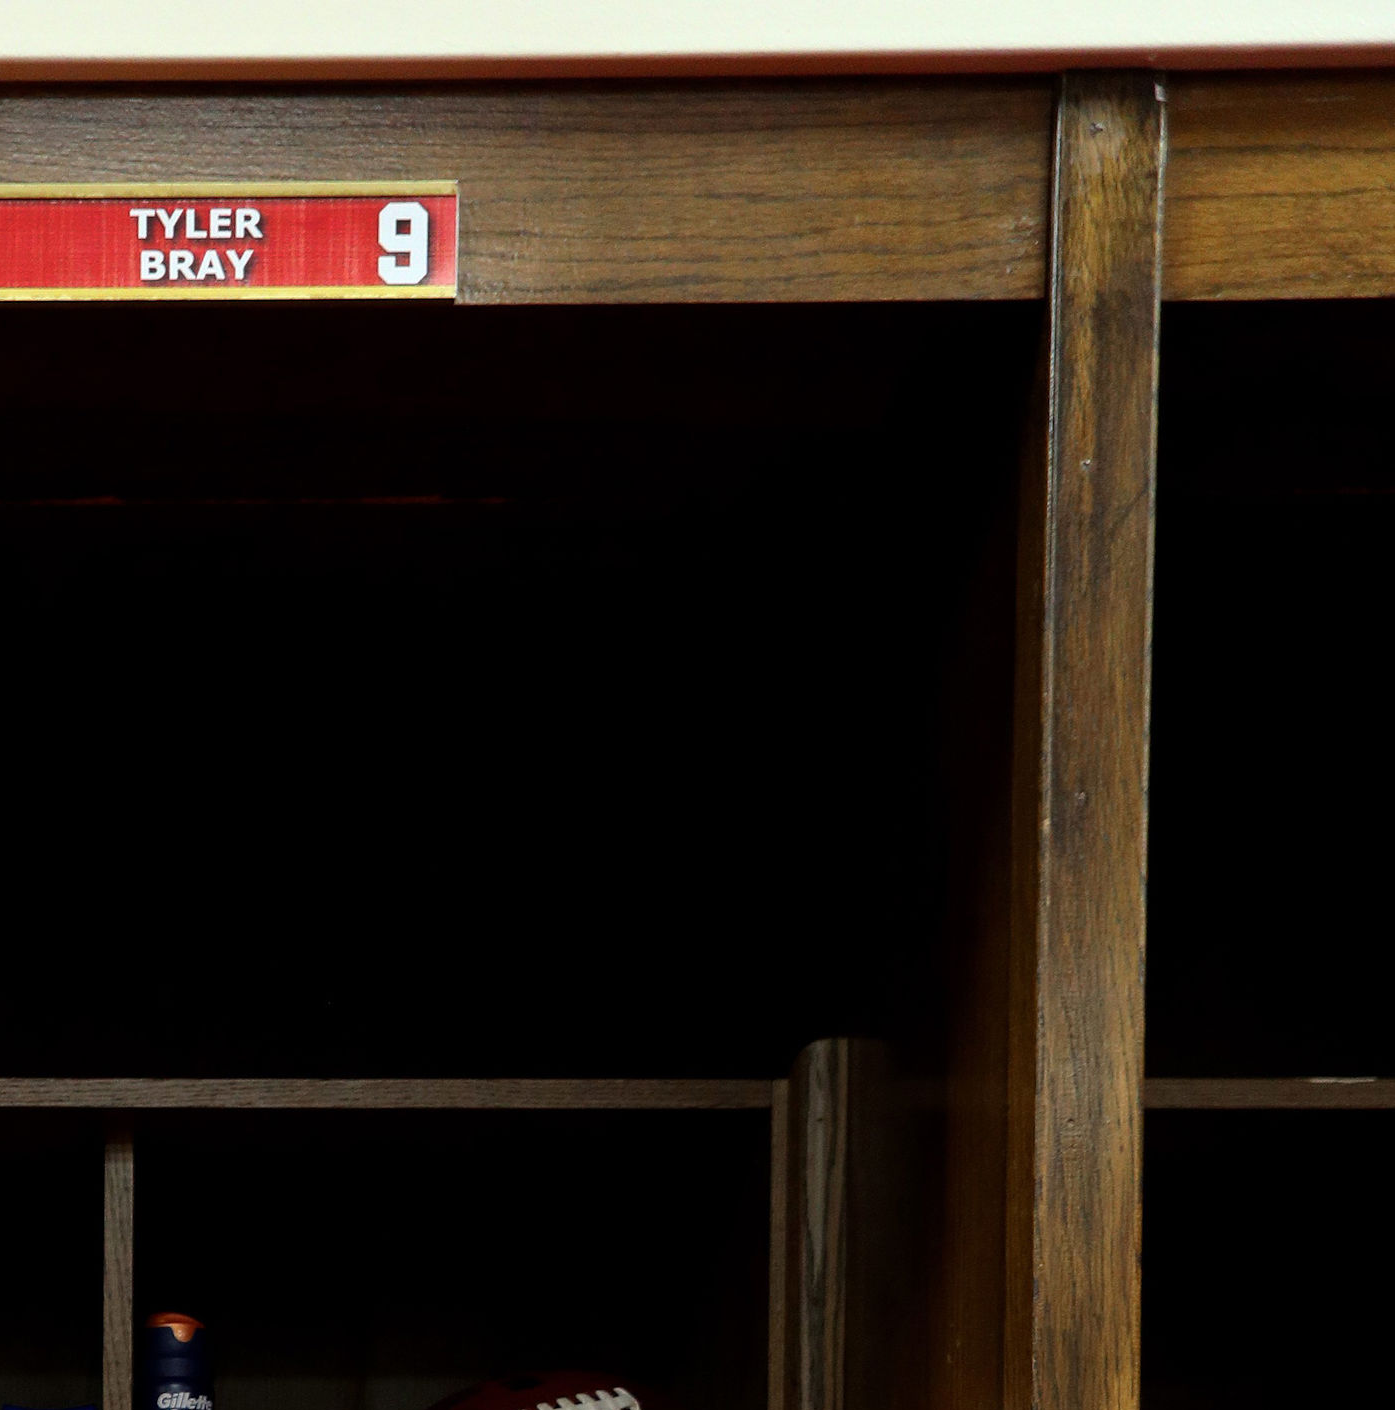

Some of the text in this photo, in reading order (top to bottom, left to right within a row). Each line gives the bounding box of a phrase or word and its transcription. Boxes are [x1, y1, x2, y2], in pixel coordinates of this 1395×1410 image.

[129, 207, 263, 240] TYLER
[377, 201, 429, 286] 9
[140, 249, 254, 281] BRAY
